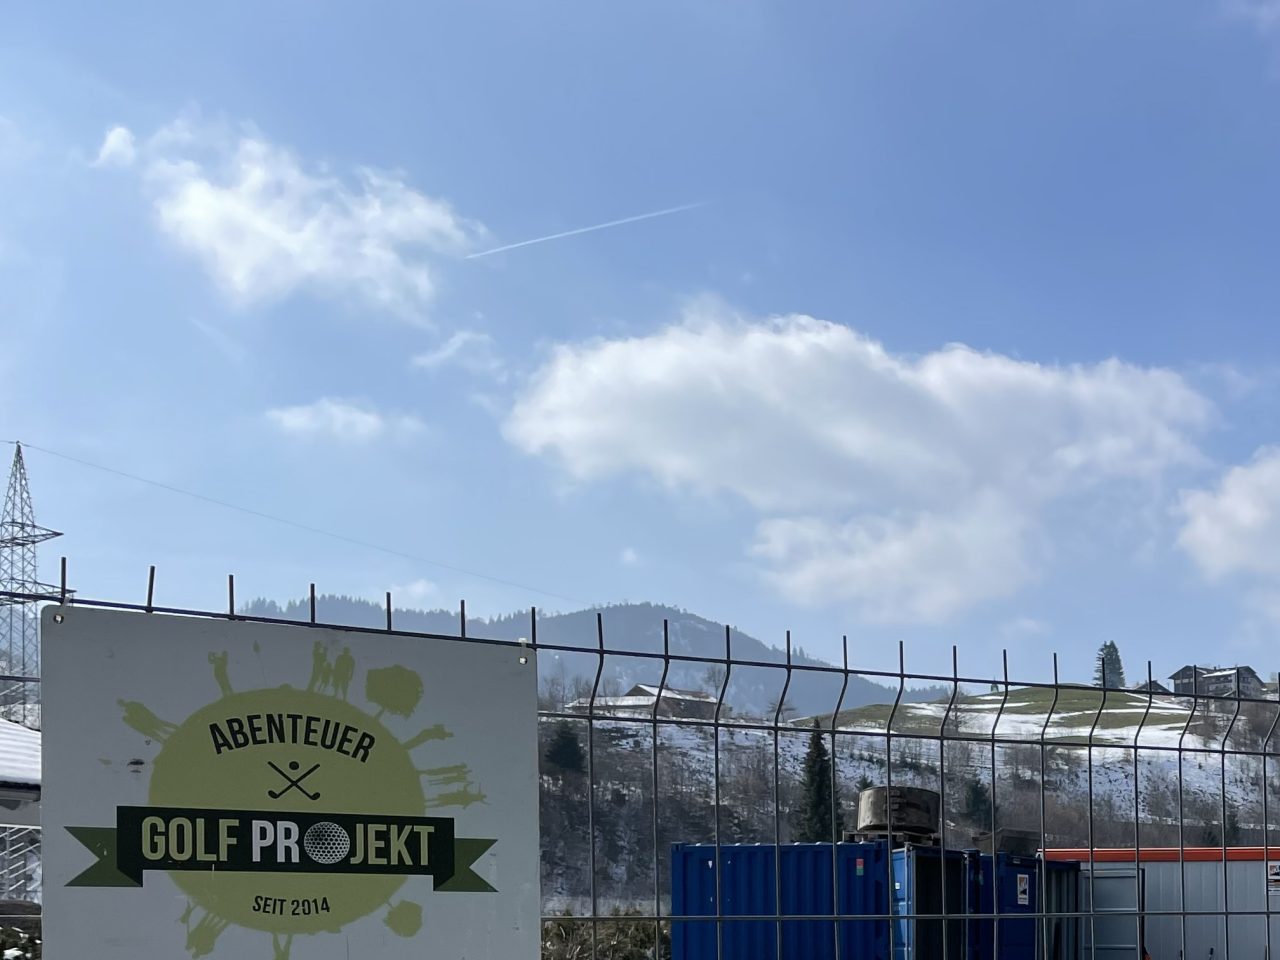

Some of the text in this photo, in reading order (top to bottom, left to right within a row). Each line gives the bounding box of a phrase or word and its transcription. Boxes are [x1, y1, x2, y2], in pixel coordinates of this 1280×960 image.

[209, 713, 376, 763] ABENTEUER
[141, 816, 240, 862] GOLF
[252, 895, 331, 916] SEIT 2014
